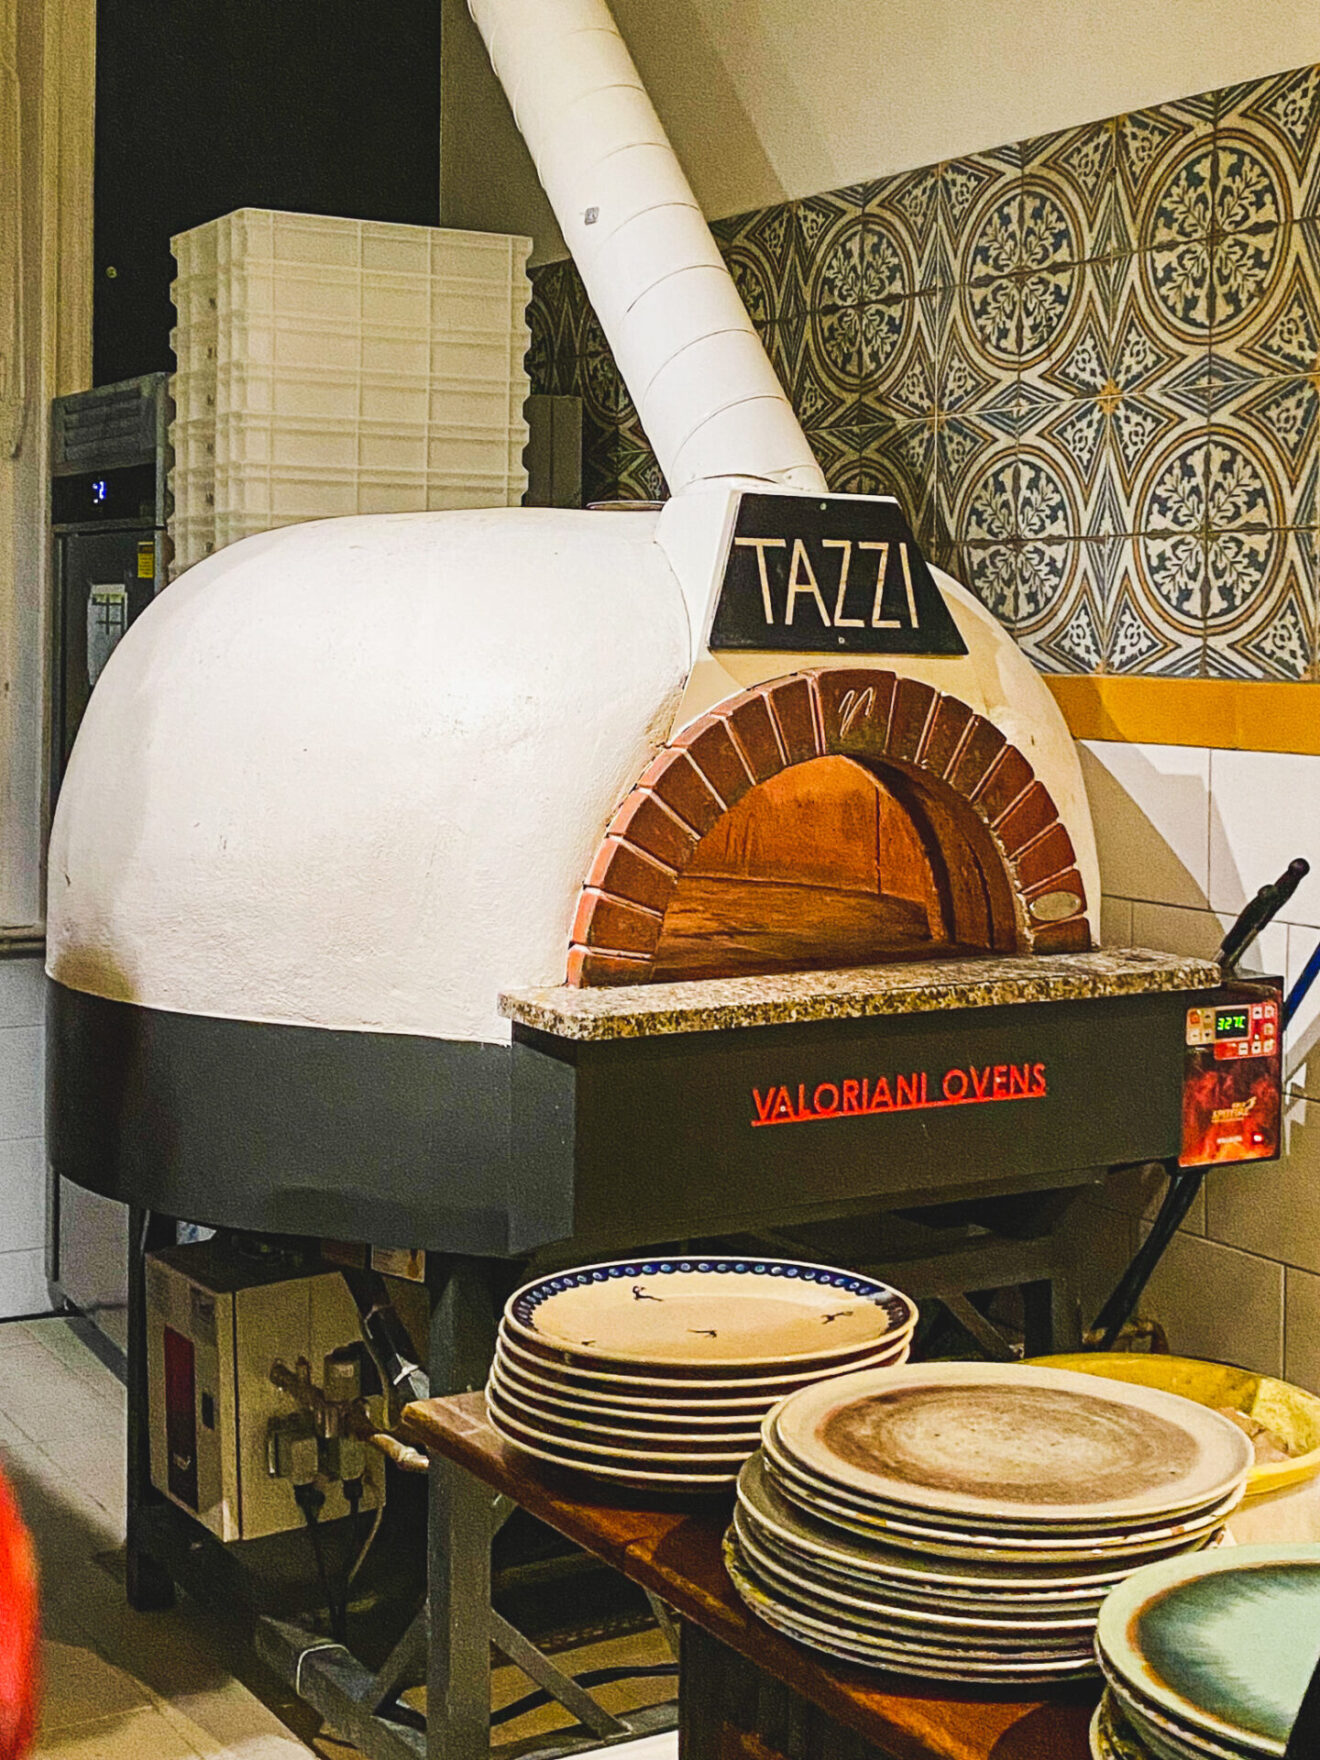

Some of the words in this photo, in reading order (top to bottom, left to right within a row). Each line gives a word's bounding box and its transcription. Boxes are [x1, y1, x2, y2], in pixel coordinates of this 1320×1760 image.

[734, 536, 920, 629] TAZZI
[751, 1071, 928, 1122] VALORIANI
[942, 1062, 1047, 1101] OVENS
